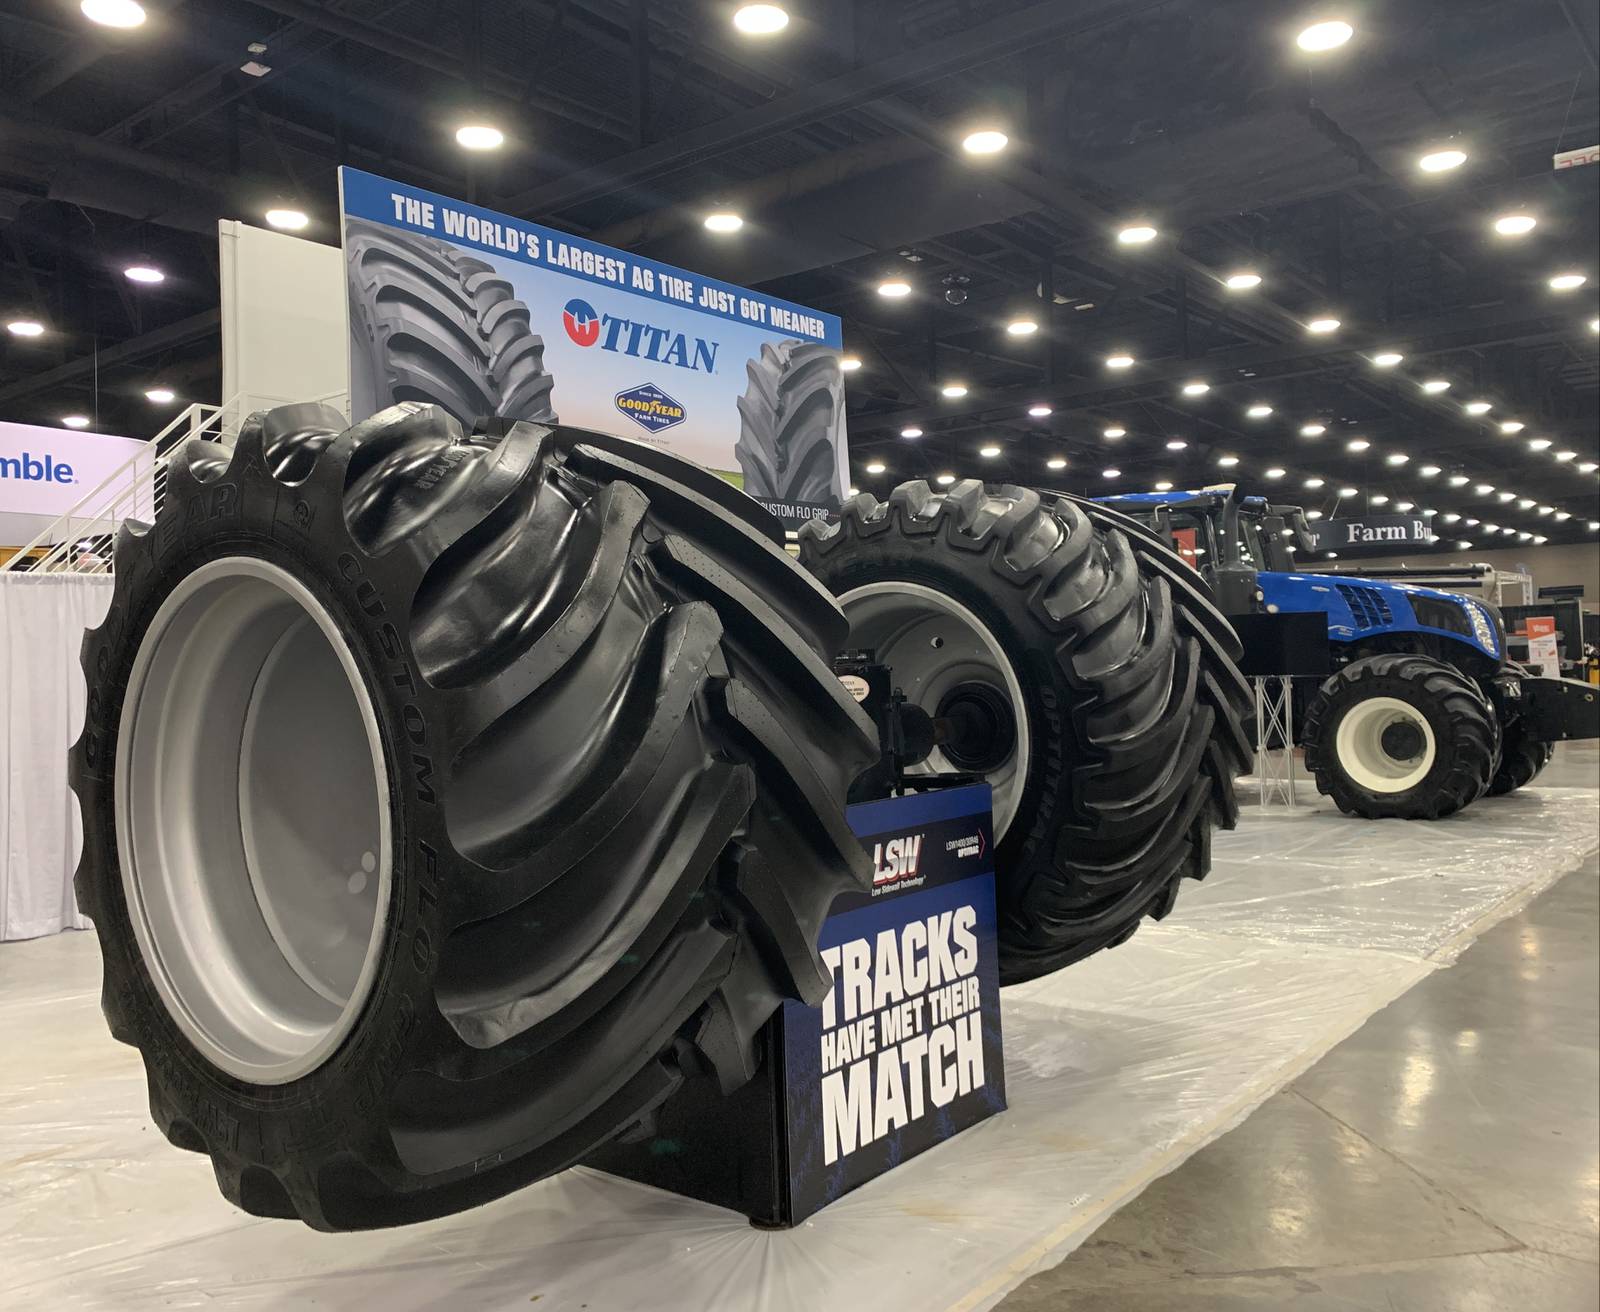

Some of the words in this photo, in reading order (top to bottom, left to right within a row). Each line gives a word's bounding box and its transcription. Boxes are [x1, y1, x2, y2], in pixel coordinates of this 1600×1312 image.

[391, 193, 434, 230] THE
[443, 208, 539, 259] WORLD'S
[547, 240, 626, 285] LARGEST
[632, 265, 655, 294] AG
[659, 273, 693, 304] TIRE
[699, 287, 736, 315] JUST
[740, 299, 767, 325] GOT
[771, 308, 825, 340] MEANER
[601, 313, 719, 374] TITAN
[618, 397, 682, 417] GOODYEAR
[796, 506, 811, 519] FLO
[812, 508, 829, 521] GRIP
[1346, 522, 1408, 544] Farm
[338, 551, 437, 806] CUSTOM
[872, 834, 921, 885] LSW
[819, 905, 978, 1030] TRACKS
[821, 1016, 875, 1072] HAVE
[881, 997, 928, 1050] MET
[929, 975, 980, 1021] THEIR
[821, 1010, 985, 1166] MATCH
